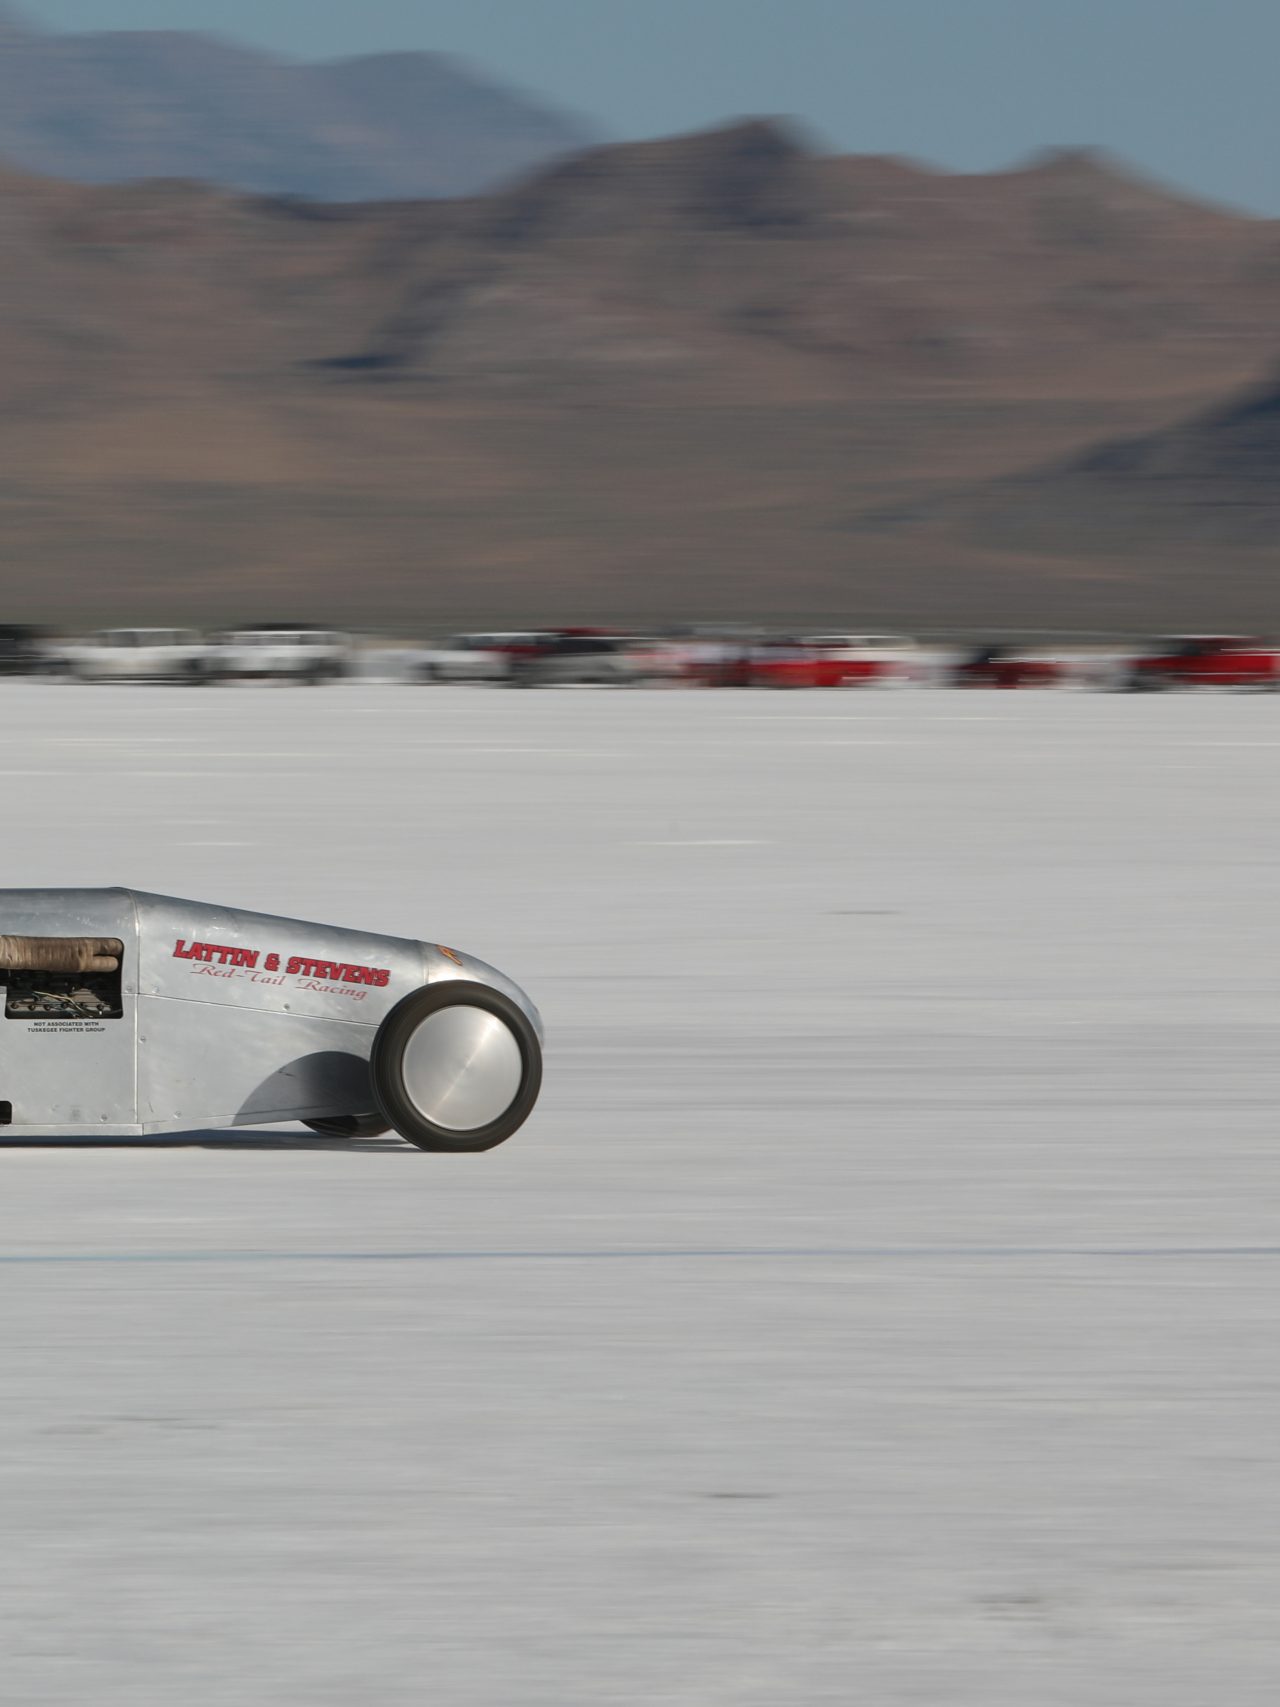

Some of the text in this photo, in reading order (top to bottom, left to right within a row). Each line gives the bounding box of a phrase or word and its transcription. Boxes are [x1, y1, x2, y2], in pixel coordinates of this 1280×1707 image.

[172, 939, 391, 987] LATTIN & STEVENS
[189, 963, 368, 1001] Red-Tail Racing
